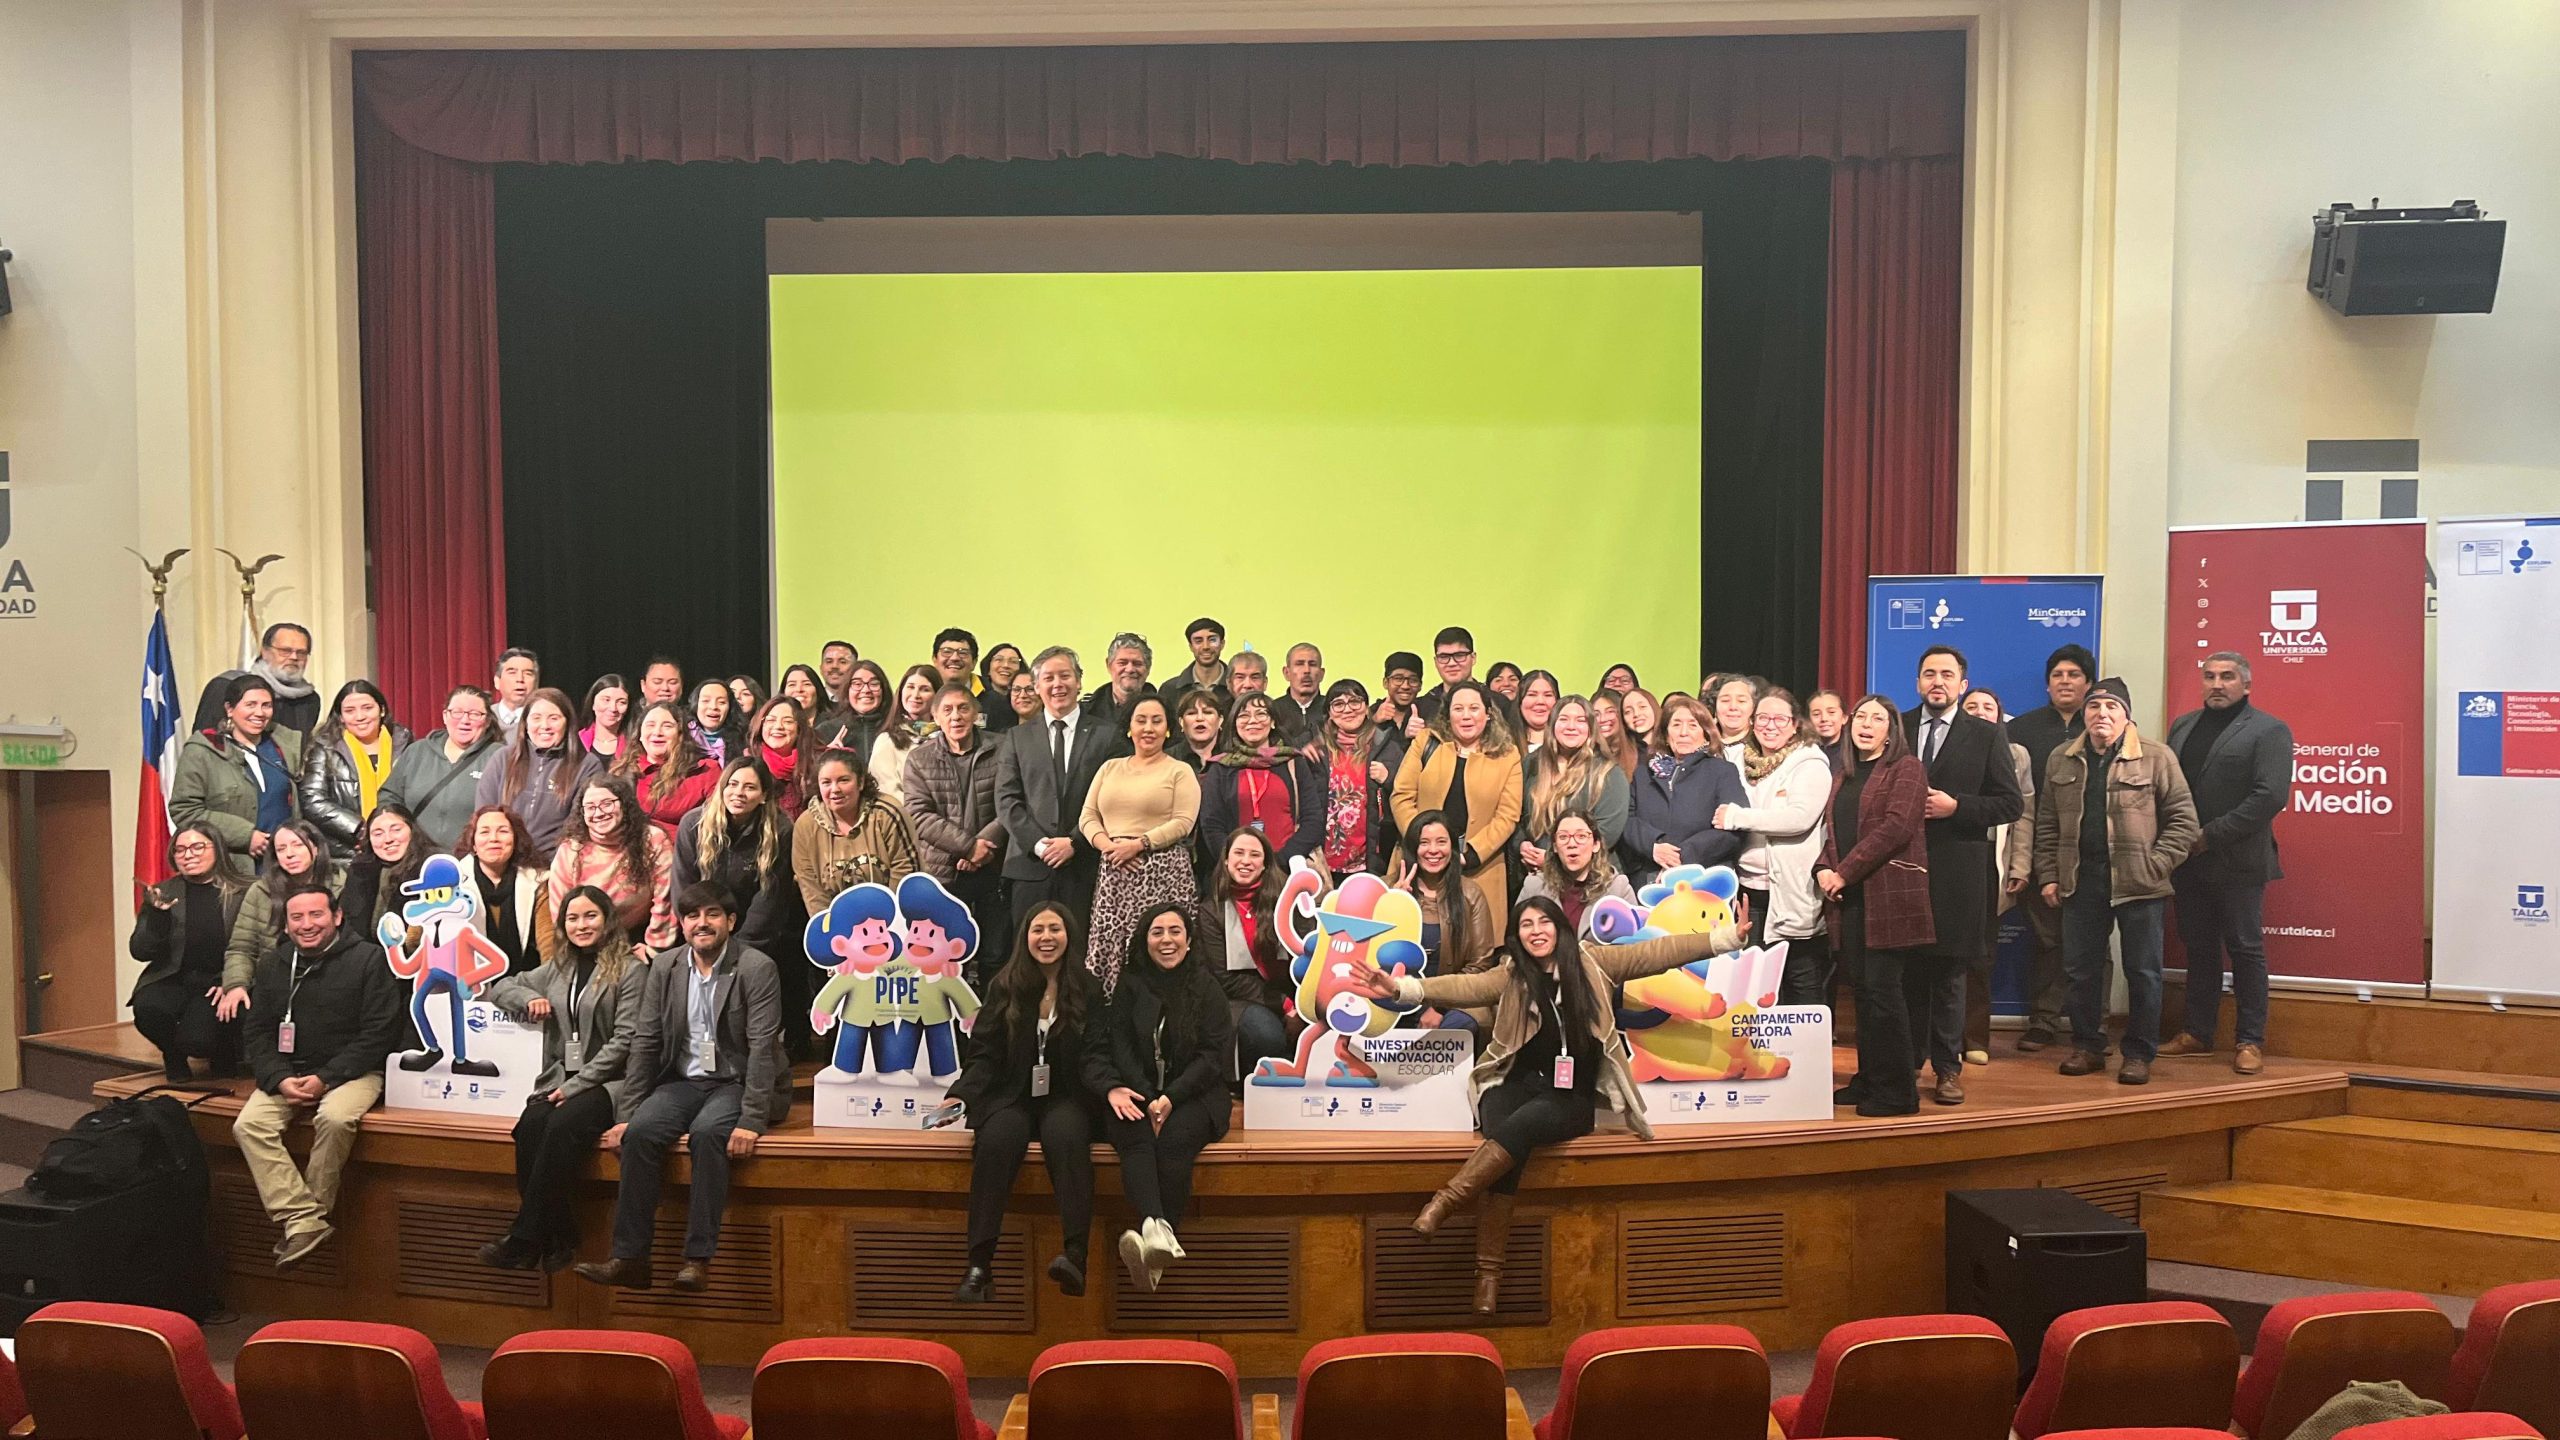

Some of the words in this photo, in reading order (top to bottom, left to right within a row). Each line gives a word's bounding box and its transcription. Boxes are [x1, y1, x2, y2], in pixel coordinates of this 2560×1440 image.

[2028, 607, 2087, 617] MinCiencia
[2259, 631, 2328, 646] TALCA
[2262, 646, 2328, 654] UNIVERSIDAD
[2282, 656, 2305, 664] CHILE
[2507, 695, 2548, 703] Ministerio
[3, 743, 58, 766] SALIDA
[2356, 743, 2380, 758] de
[2291, 759, 2388, 785] lación
[2294, 789, 2394, 815] Medio
[2511, 908, 2550, 918] TALCA
[875, 976, 920, 1005] PIPE
[1731, 1012, 1823, 1025] CAMPAMENTO
[1731, 1025, 1793, 1038] EXPLORA
[1364, 1038, 1465, 1052] INVESTIGACIÓN
[1750, 1038, 1771, 1049] VA!
[1364, 1051, 1373, 1063] E
[1374, 1050, 1455, 1063] INNOVACIÓN
[1397, 1063, 1456, 1076] ESCOLAR
